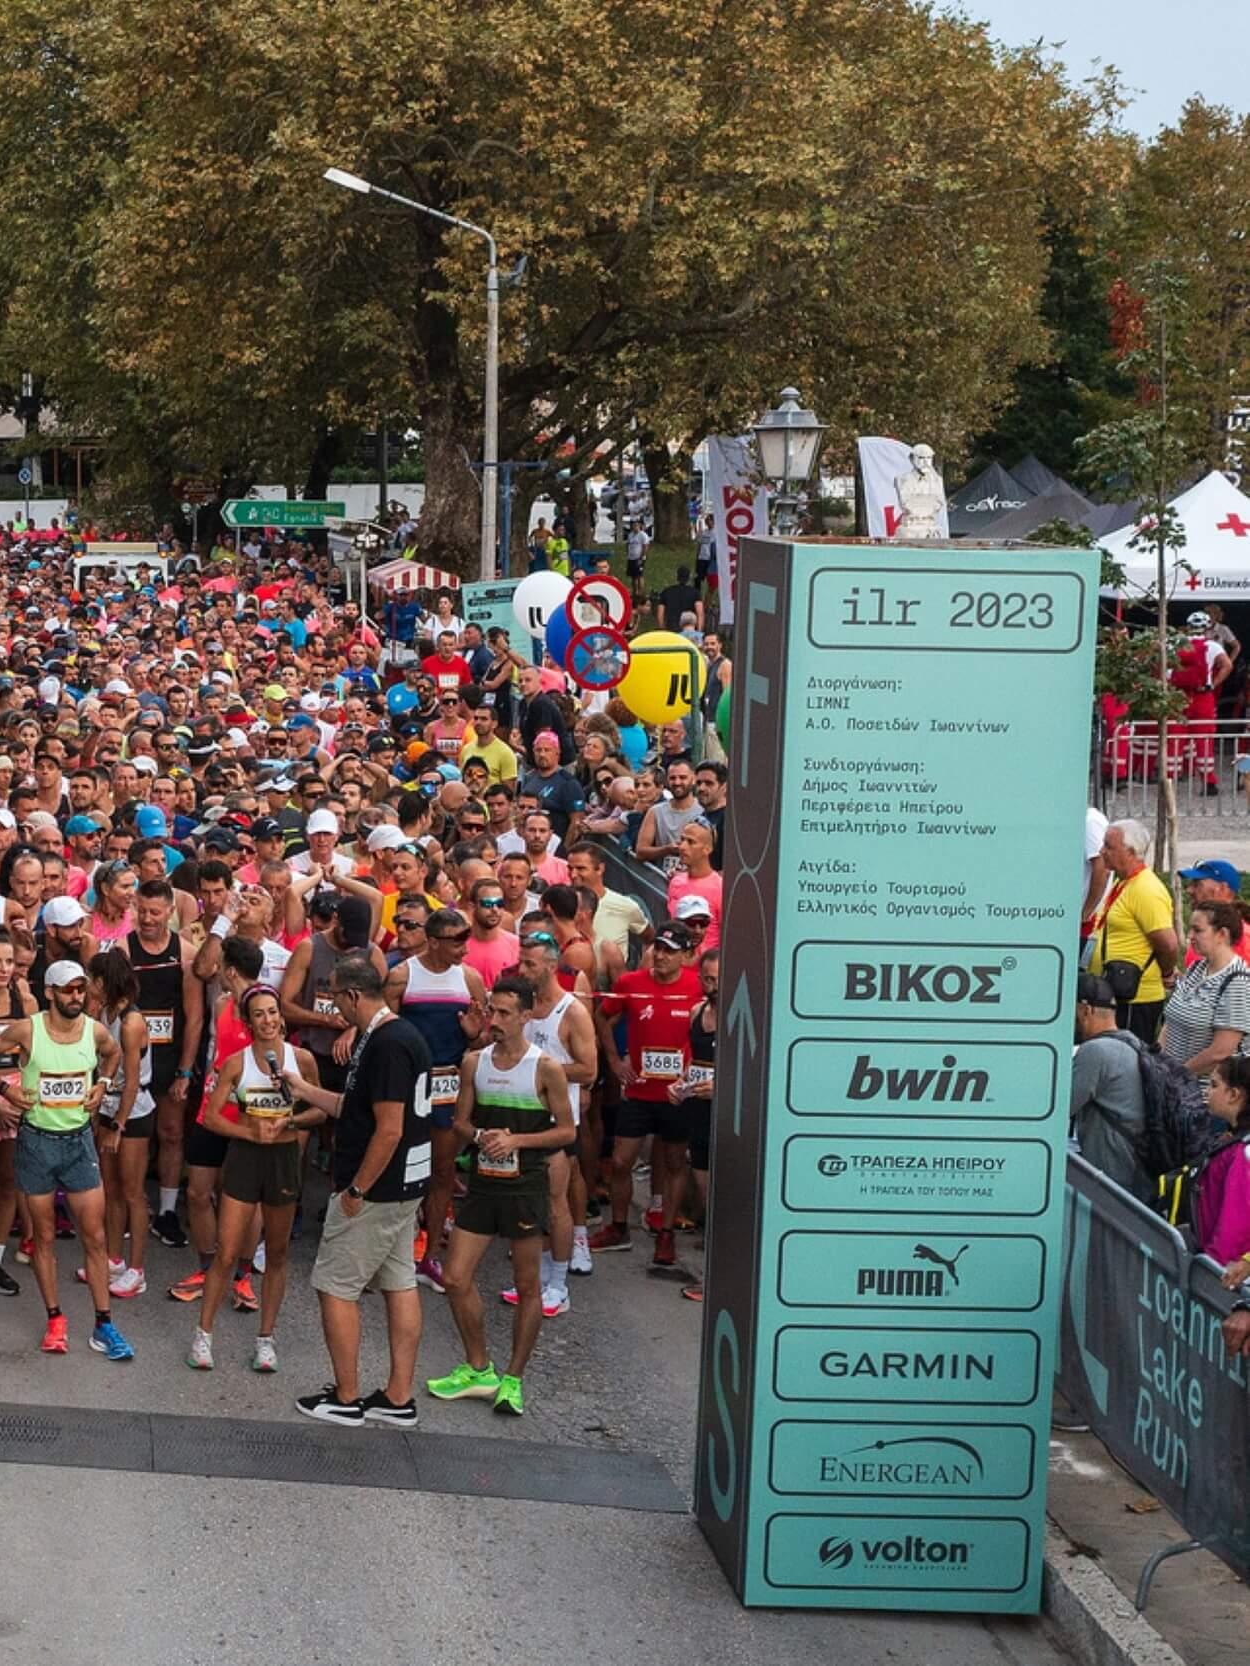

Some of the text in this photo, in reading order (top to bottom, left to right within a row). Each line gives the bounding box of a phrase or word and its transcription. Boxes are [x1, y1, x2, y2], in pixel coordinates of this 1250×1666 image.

[841, 587, 1054, 629] ilr 2023
[807, 675, 903, 692] Διοργάνωση:
[806, 696, 850, 710] LIMNI
[846, 718, 920, 732] Ποσειδών
[929, 719, 1010, 734] Ιωαννίνων
[803, 757, 925, 775] Συνδιοργάνωση:
[802, 778, 938, 794] Δήμος Ιωαννιτών
[801, 799, 963, 816] Περιφέρεια Ηπείρου
[800, 819, 996, 836] Επιμελητήριο Ιωαννίνων
[798, 858, 857, 875] Αιγίδα:
[798, 879, 966, 898] Υπουργείο Τουρισμού
[797, 900, 1065, 920] Ελληνικός Οργανισμός Τουρισμού
[645, 1055, 682, 1069] 3685
[846, 1055, 990, 1103] bwin
[42, 1081, 83, 1096] 3002
[850, 1154, 1006, 1170] ΤΡΑΠΕΖΑ ΗΠΕΙΡΟΥ
[870, 1186, 915, 1195] ΤΡΑΠΕΖΑ
[917, 1187, 935, 1195] ΤΟΥ
[938, 1187, 970, 1197] ΤΟΠΟΥ
[972, 1188, 994, 1198] ΜΑΣ
[857, 1268, 944, 1297] PUMA
[819, 1352, 994, 1381] GARMIN
[1137, 1314, 1204, 1428] Lake
[1133, 1386, 1189, 1489] Run
[861, 1535, 968, 1563] volton
